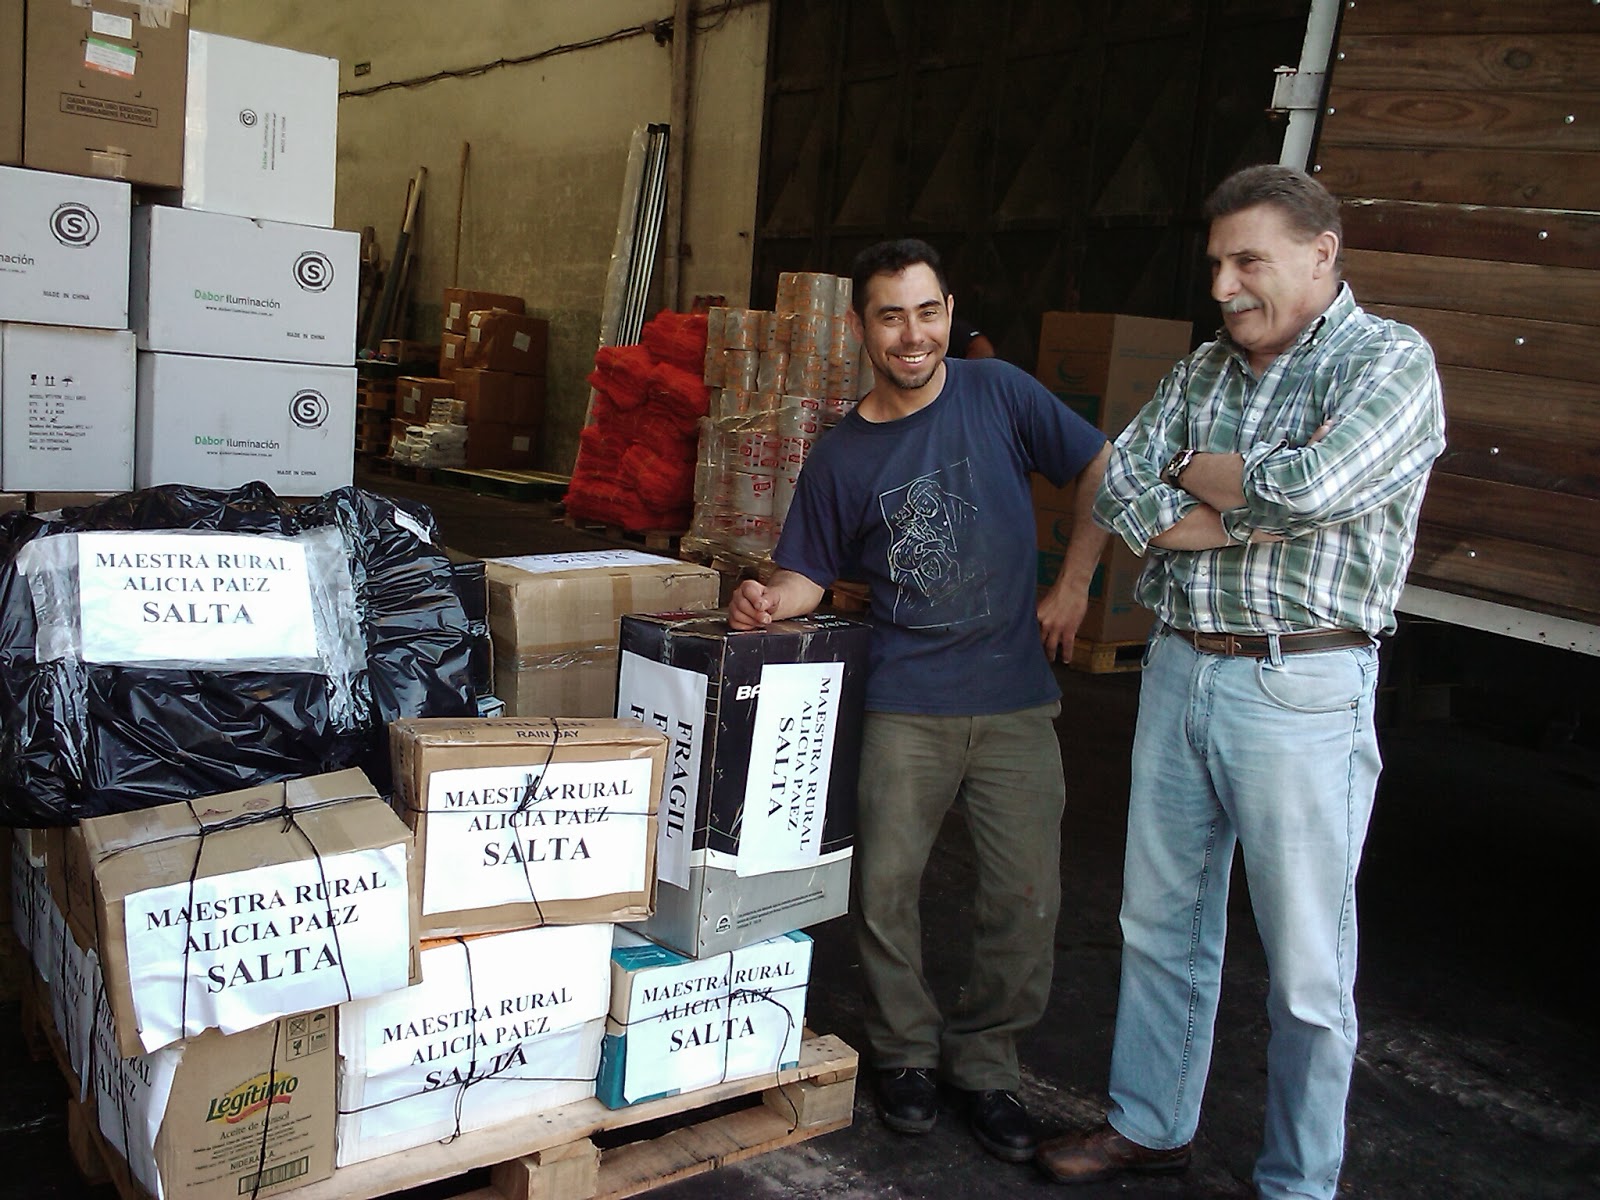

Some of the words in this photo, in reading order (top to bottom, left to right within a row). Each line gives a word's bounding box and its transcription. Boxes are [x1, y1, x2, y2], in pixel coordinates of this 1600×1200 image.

[43, 290, 60, 298] MADE
[286, 331, 300, 339] MADE
[95, 552, 210, 570] MAESTRA
[217, 553, 291, 572] RURAL
[123, 576, 205, 592] ALICIA
[212, 577, 271, 593] PAEZ
[142, 601, 254, 624] SALTA
[516, 730, 550, 738] RAIN
[795, 700, 813, 771] ALICIA
[809, 677, 832, 775] MAESTRA
[561, 779, 633, 800] RURAL
[666, 719, 693, 839] FRAGIL
[768, 717, 795, 818] SALTA
[467, 810, 547, 833] ALICIA
[554, 806, 610, 826] PAEZ
[787, 778, 803, 831] PAEZ
[800, 781, 818, 851] RURAL
[482, 837, 592, 867] SALTA
[146, 889, 286, 931] MAESTRA
[295, 871, 388, 905] RURAL
[182, 920, 281, 955] ALICIA
[289, 904, 360, 935] PAEZ
[207, 943, 339, 994] SALTA
[641, 973, 730, 1005] MAESTRA
[734, 961, 795, 985] RURAL
[382, 1005, 493, 1045] MAESTRA
[500, 987, 573, 1017] RURAL
[658, 996, 721, 1024] ALICIA
[410, 1032, 488, 1066] ALICIA
[496, 1016, 551, 1044] PAEZ
[669, 1015, 756, 1053] SALTA
[422, 1047, 529, 1093] SALTA
[205, 1076, 299, 1122] Legítimo
[219, 1125, 246, 1141] Aceite
[248, 1122, 259, 1131] de
